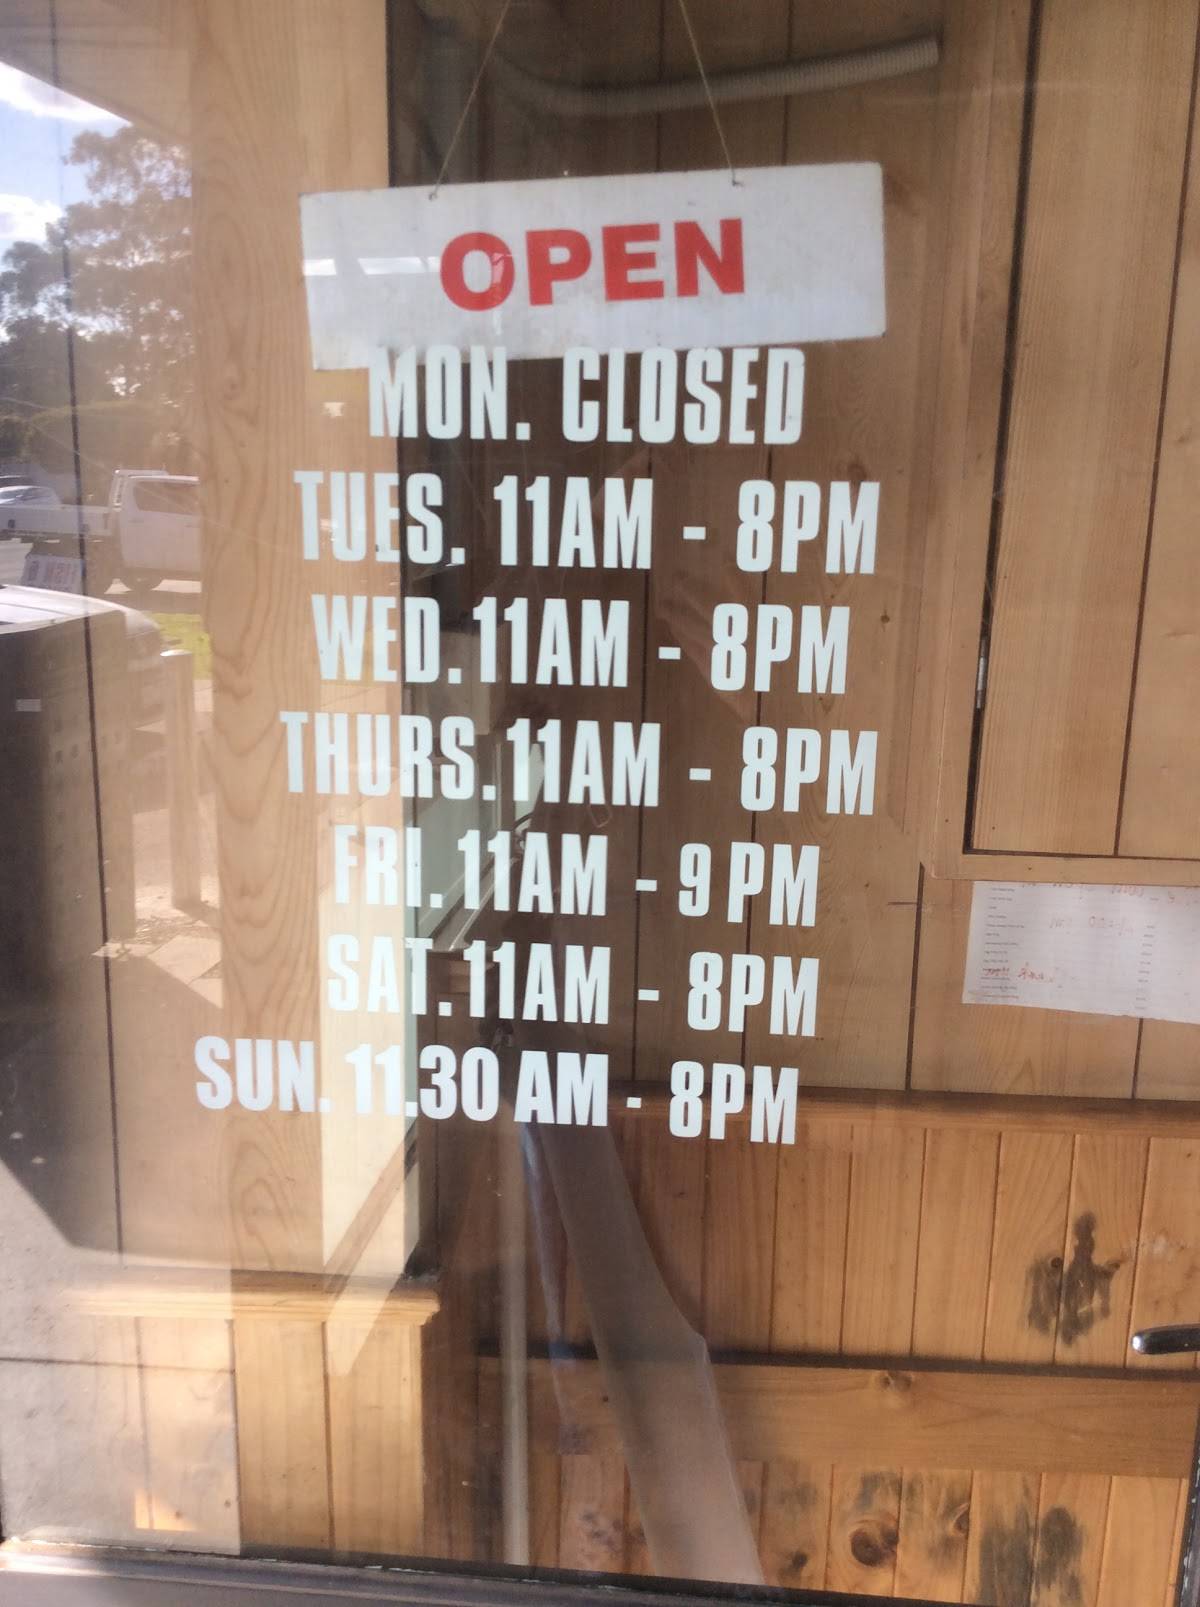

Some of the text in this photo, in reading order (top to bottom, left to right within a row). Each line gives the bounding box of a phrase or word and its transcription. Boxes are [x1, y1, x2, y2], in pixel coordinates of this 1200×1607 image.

[440, 218, 744, 311] OPEN
[369, 345, 806, 444] MON. CLOSED
[294, 471, 465, 565] TUES.
[493, 475, 652, 569] 11AM
[736, 480, 880, 574] 8PM
[311, 594, 462, 685] WED.
[473, 596, 629, 687] 11AM
[710, 603, 850, 694] 8PM
[279, 712, 495, 801] THURS.
[507, 718, 660, 807] 11AM
[741, 726, 878, 816] 8PM
[334, 825, 442, 908] FRI.
[457, 830, 608, 916] 11AM
[678, 843, 711, 917] 9
[727, 841, 819, 927] PM
[327, 934, 451, 1016] SAT.
[463, 940, 611, 1025] 11AM
[687, 952, 819, 1037] 8PM
[194, 1036, 330, 1112] SUN.
[346, 1043, 499, 1122] 11.30
[514, 1051, 608, 1126] AM
[669, 1060, 799, 1145] 8PM
